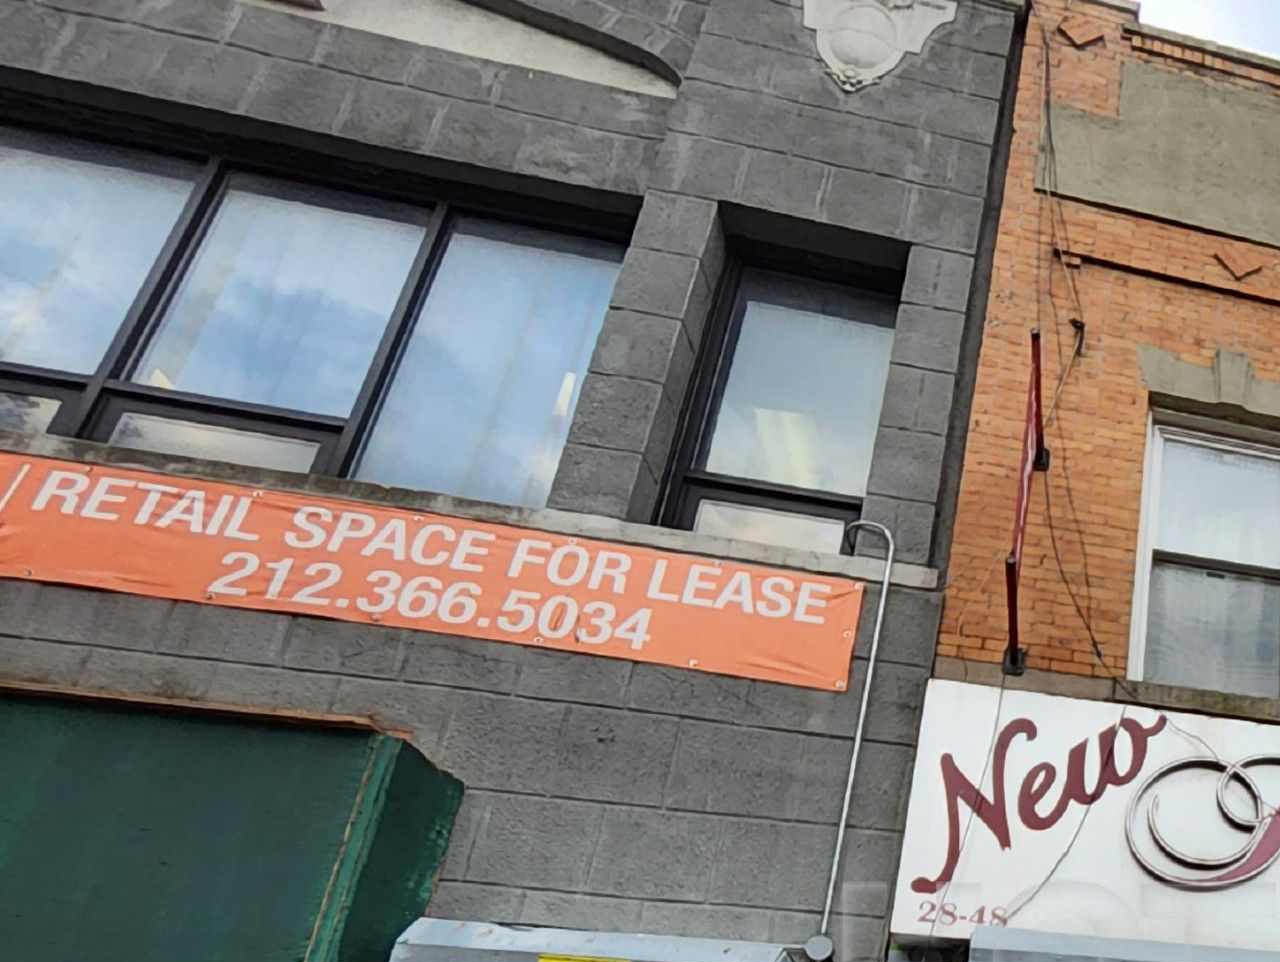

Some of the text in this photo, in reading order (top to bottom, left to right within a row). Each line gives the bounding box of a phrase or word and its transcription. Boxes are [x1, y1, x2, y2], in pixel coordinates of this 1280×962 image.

[31, 470, 831, 624] RETAIL SPACE FOR LEASE
[208, 552, 653, 650] 212.366.5034
[911, 714, 1167, 894] New
[918, 901, 1008, 927] 28-48
